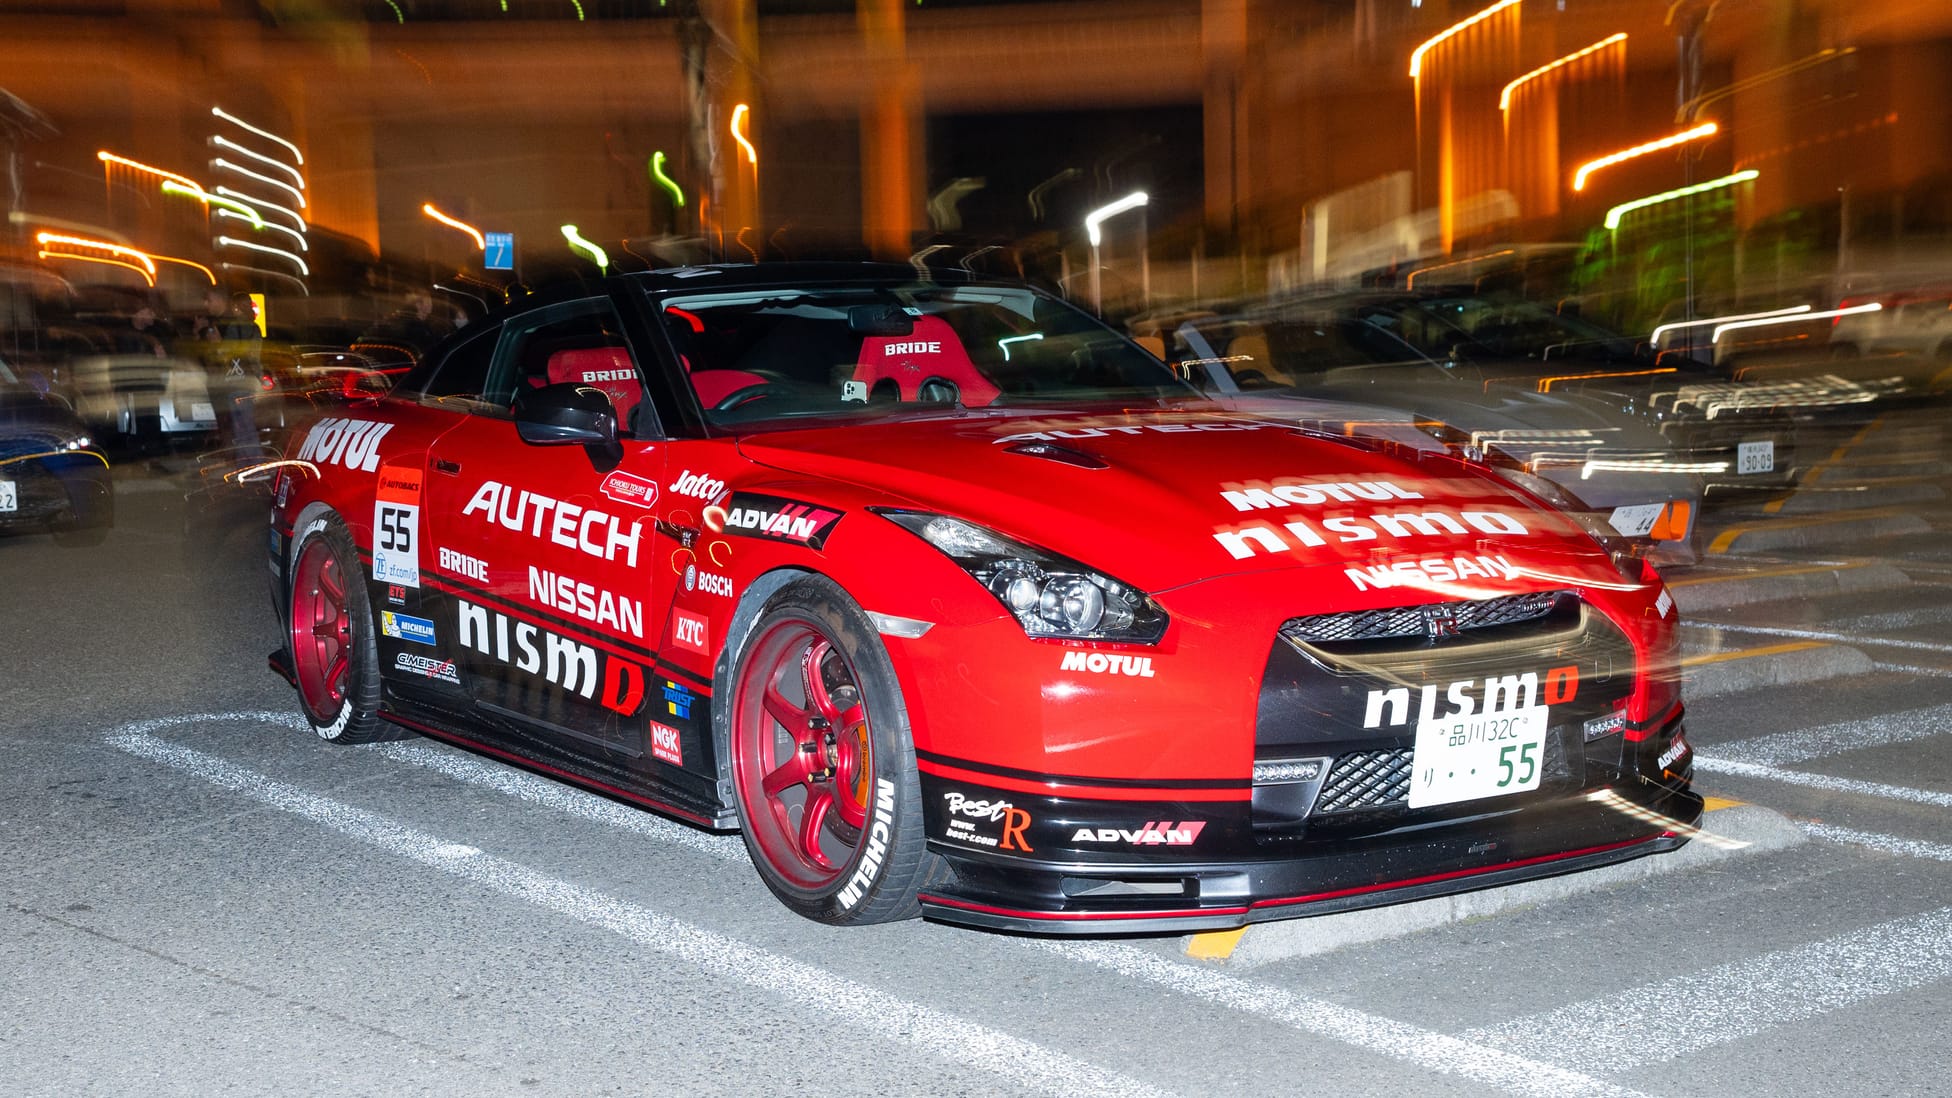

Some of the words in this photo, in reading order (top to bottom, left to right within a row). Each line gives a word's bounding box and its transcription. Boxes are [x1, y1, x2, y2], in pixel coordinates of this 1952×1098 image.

[885, 342, 941, 356] BRIDE
[297, 417, 395, 473] MOTUL
[992, 422, 1283, 444] AUTECH
[387, 480, 420, 492] AUTOBACS
[1220, 481, 1424, 512] MOTUL
[381, 507, 411, 553] 55
[462, 481, 642, 568] AUTECH
[726, 508, 817, 538] ADVAN
[1213, 511, 1530, 561] nismo
[439, 547, 490, 583] BRIDE
[1344, 555, 1520, 592] NISSAN
[698, 571, 733, 598] BOSCH
[528, 566, 644, 638] NISSAN
[401, 621, 434, 636] MICHELIN
[676, 616, 705, 647] KTC
[458, 600, 646, 717] nismo
[1061, 652, 1155, 678] MOTUL
[661, 686, 695, 708] TRUST
[1363, 666, 1579, 729] nismo
[652, 724, 678, 753] NGK
[1497, 742, 1538, 788] 55
[1658, 740, 1687, 770] ADVAN
[944, 792, 1013, 822] Best
[1000, 807, 1034, 852] R
[946, 827, 998, 847] best-r.com
[950, 819, 976, 831] www.
[1071, 827, 1193, 844] ADVAN
[837, 778, 895, 910] MICHELIN
